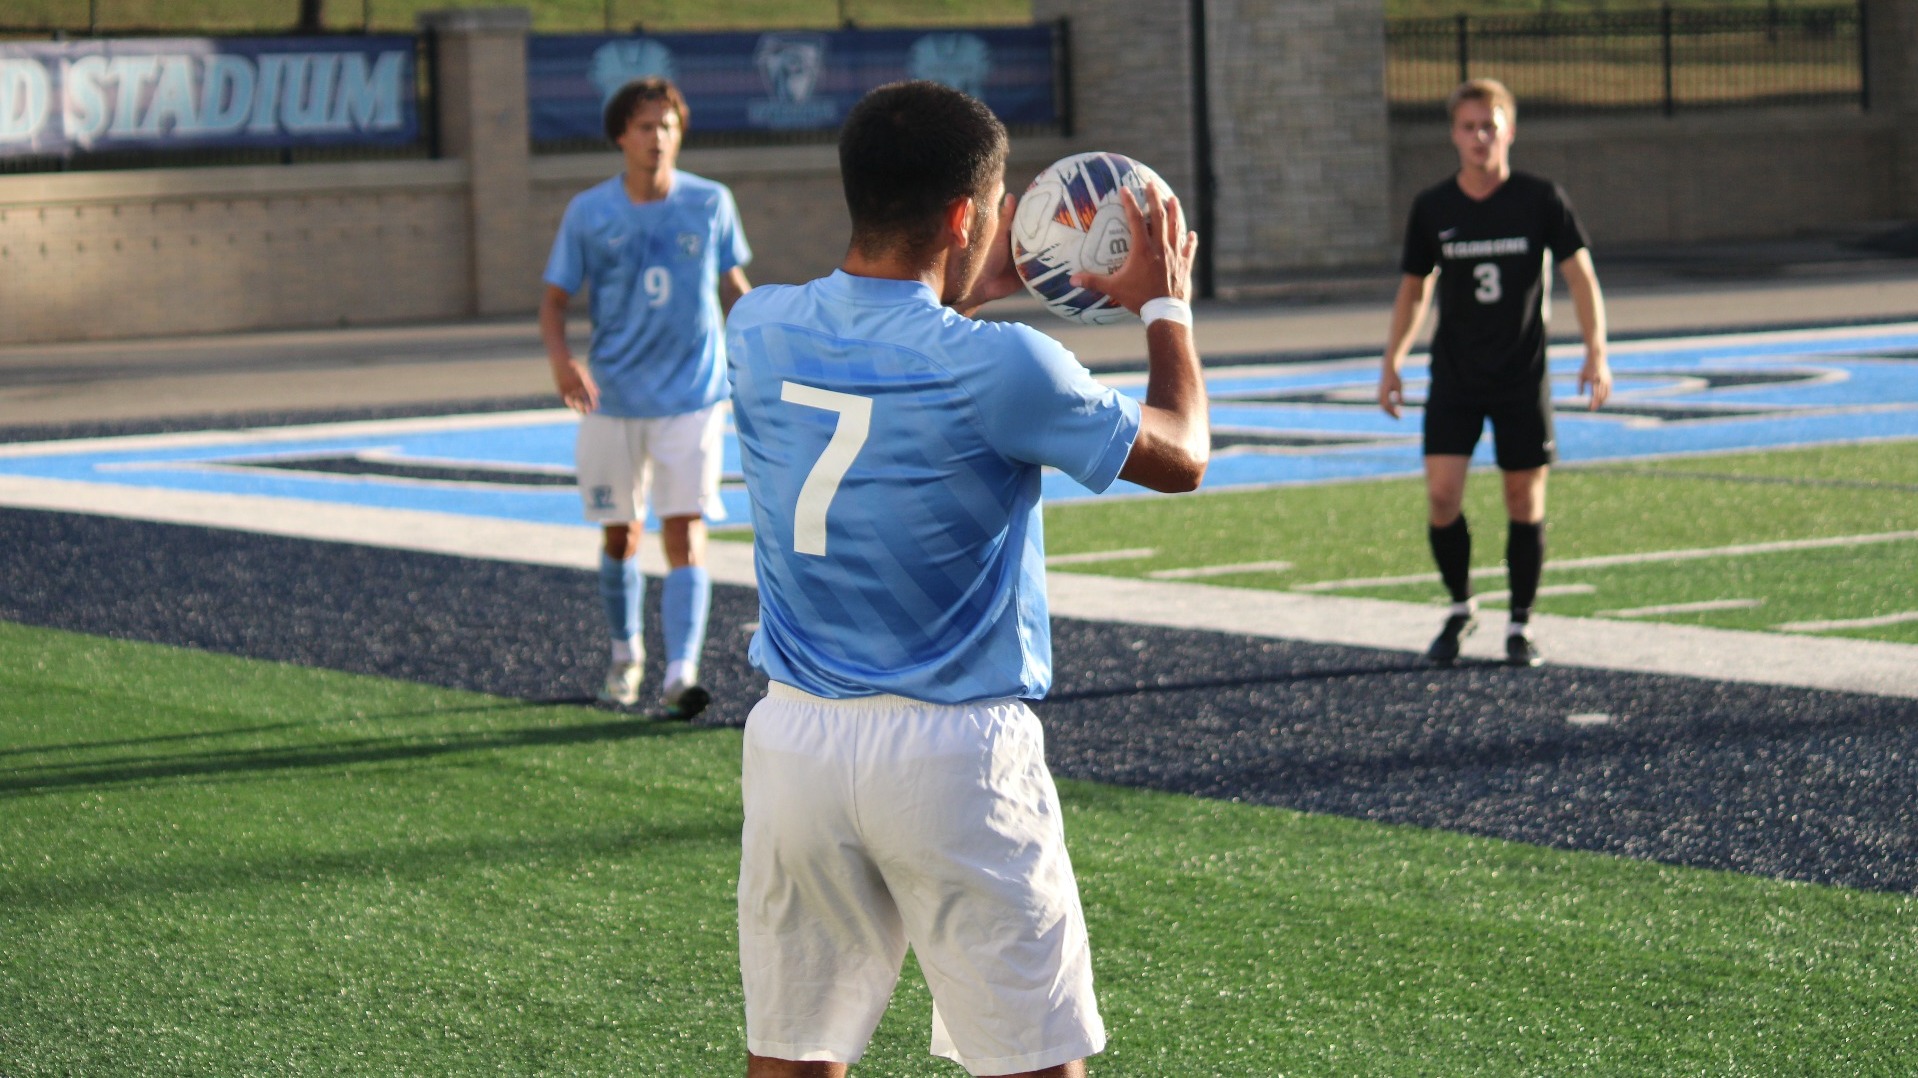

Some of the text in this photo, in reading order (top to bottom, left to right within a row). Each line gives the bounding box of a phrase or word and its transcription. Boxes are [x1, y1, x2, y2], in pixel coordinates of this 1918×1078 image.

[63, 50, 407, 141] STADIUM
[643, 265, 672, 308] 9
[1473, 262, 1502, 304] 3
[780, 380, 873, 557] 7
